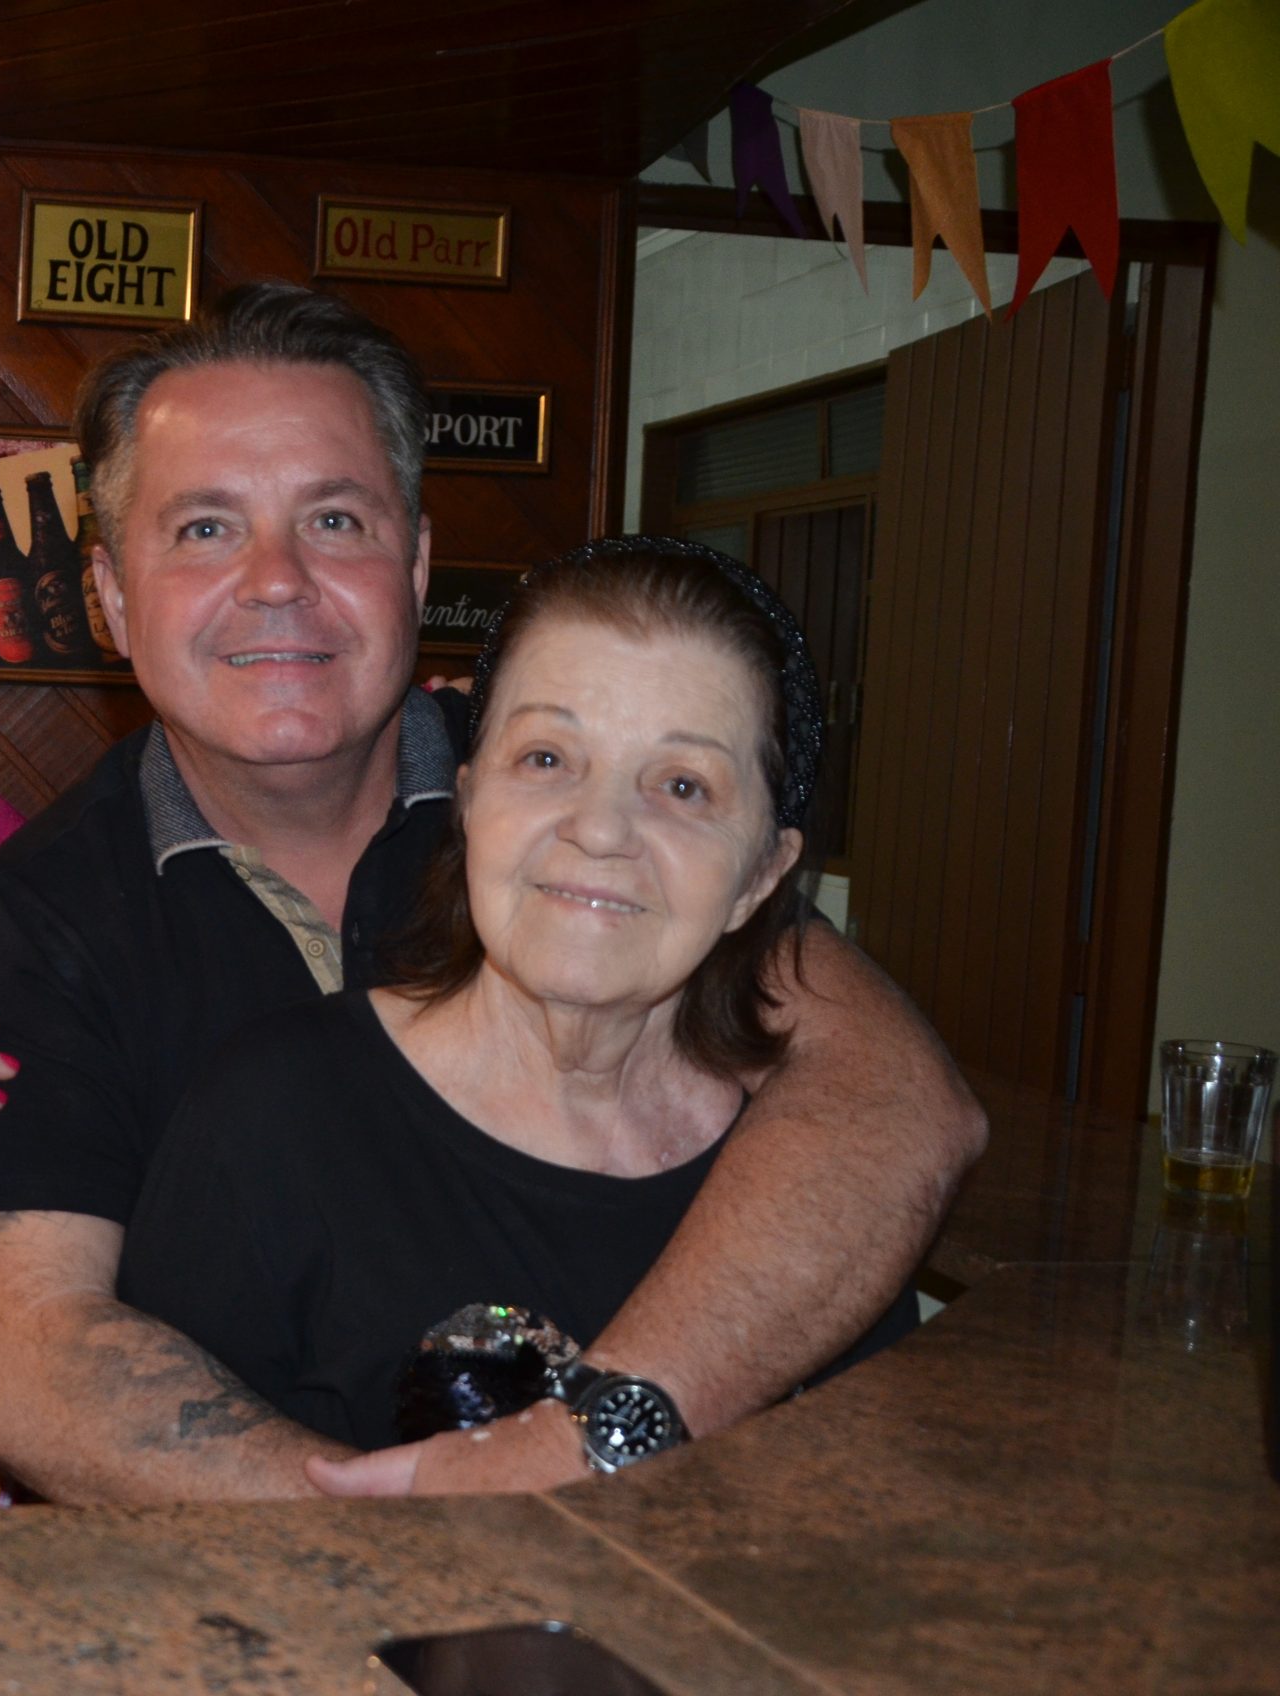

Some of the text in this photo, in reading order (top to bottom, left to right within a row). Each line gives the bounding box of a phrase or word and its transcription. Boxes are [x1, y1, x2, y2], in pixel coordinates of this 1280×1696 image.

[68, 218, 149, 262] OLD
[334, 216, 491, 267] Old Parr
[46, 260, 176, 307] EIGHT
